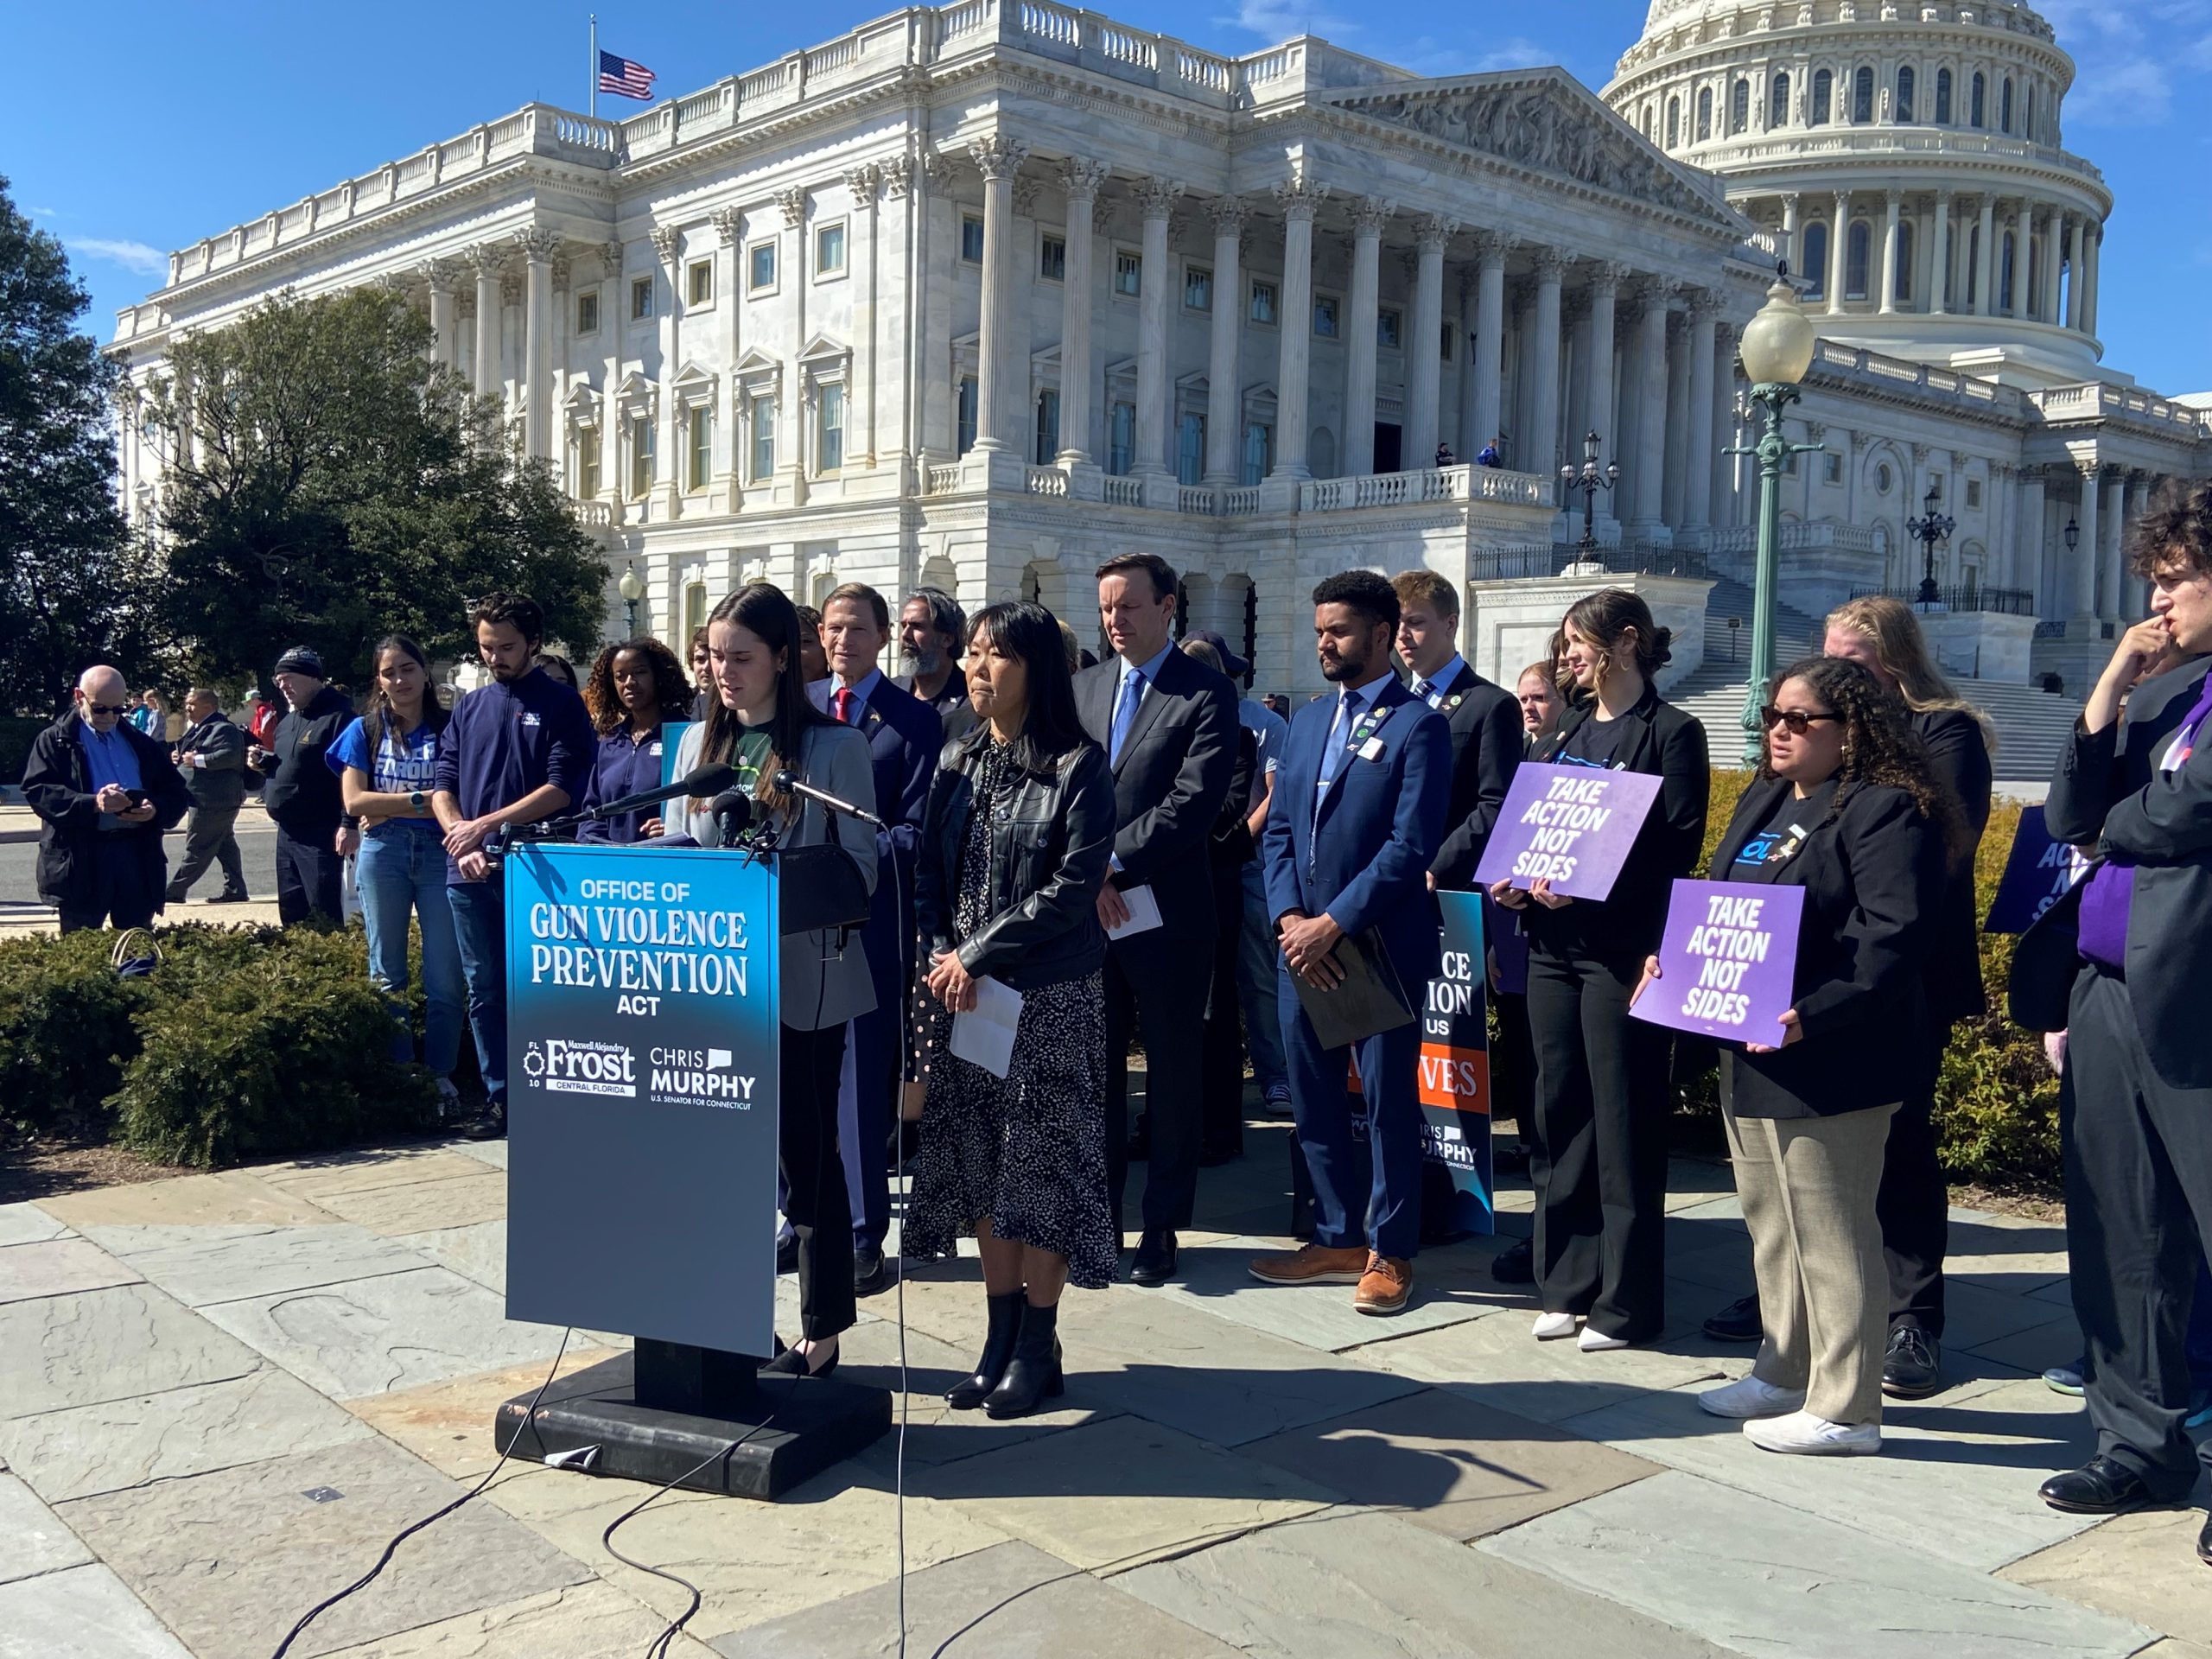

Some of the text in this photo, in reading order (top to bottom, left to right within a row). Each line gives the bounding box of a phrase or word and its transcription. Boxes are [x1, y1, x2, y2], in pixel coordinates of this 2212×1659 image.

[1546, 777, 1609, 804] TAKE
[1521, 800, 1611, 831] ACTION
[1529, 827, 1582, 855] NOT
[1512, 851, 1577, 881] SIDES
[581, 879, 690, 902] OFFICE OF
[1707, 895, 1764, 929] TAKE
[531, 903, 748, 950] GUN VIOLENCE
[1686, 925, 1771, 963] ACTION
[531, 944, 748, 996] PREVENTION
[1698, 957, 1749, 991] NOT
[616, 995, 660, 1016] ACT
[1681, 988, 1751, 1026] SIDES
[1426, 1018, 1450, 1035] US
[528, 1041, 540, 1050] FL
[568, 1039, 594, 1050] Maxwell
[650, 1047, 703, 1068] CHRIS
[546, 1039, 636, 1082] Frost
[529, 1078, 540, 1088] 10
[556, 1082, 626, 1094] CENTRAL FLORIDA
[651, 1069, 756, 1099] MURPHY
[664, 1096, 692, 1104] SENATOR
[692, 1097, 705, 1106] FOR
[706, 1099, 751, 1110] CONNECTICUT
